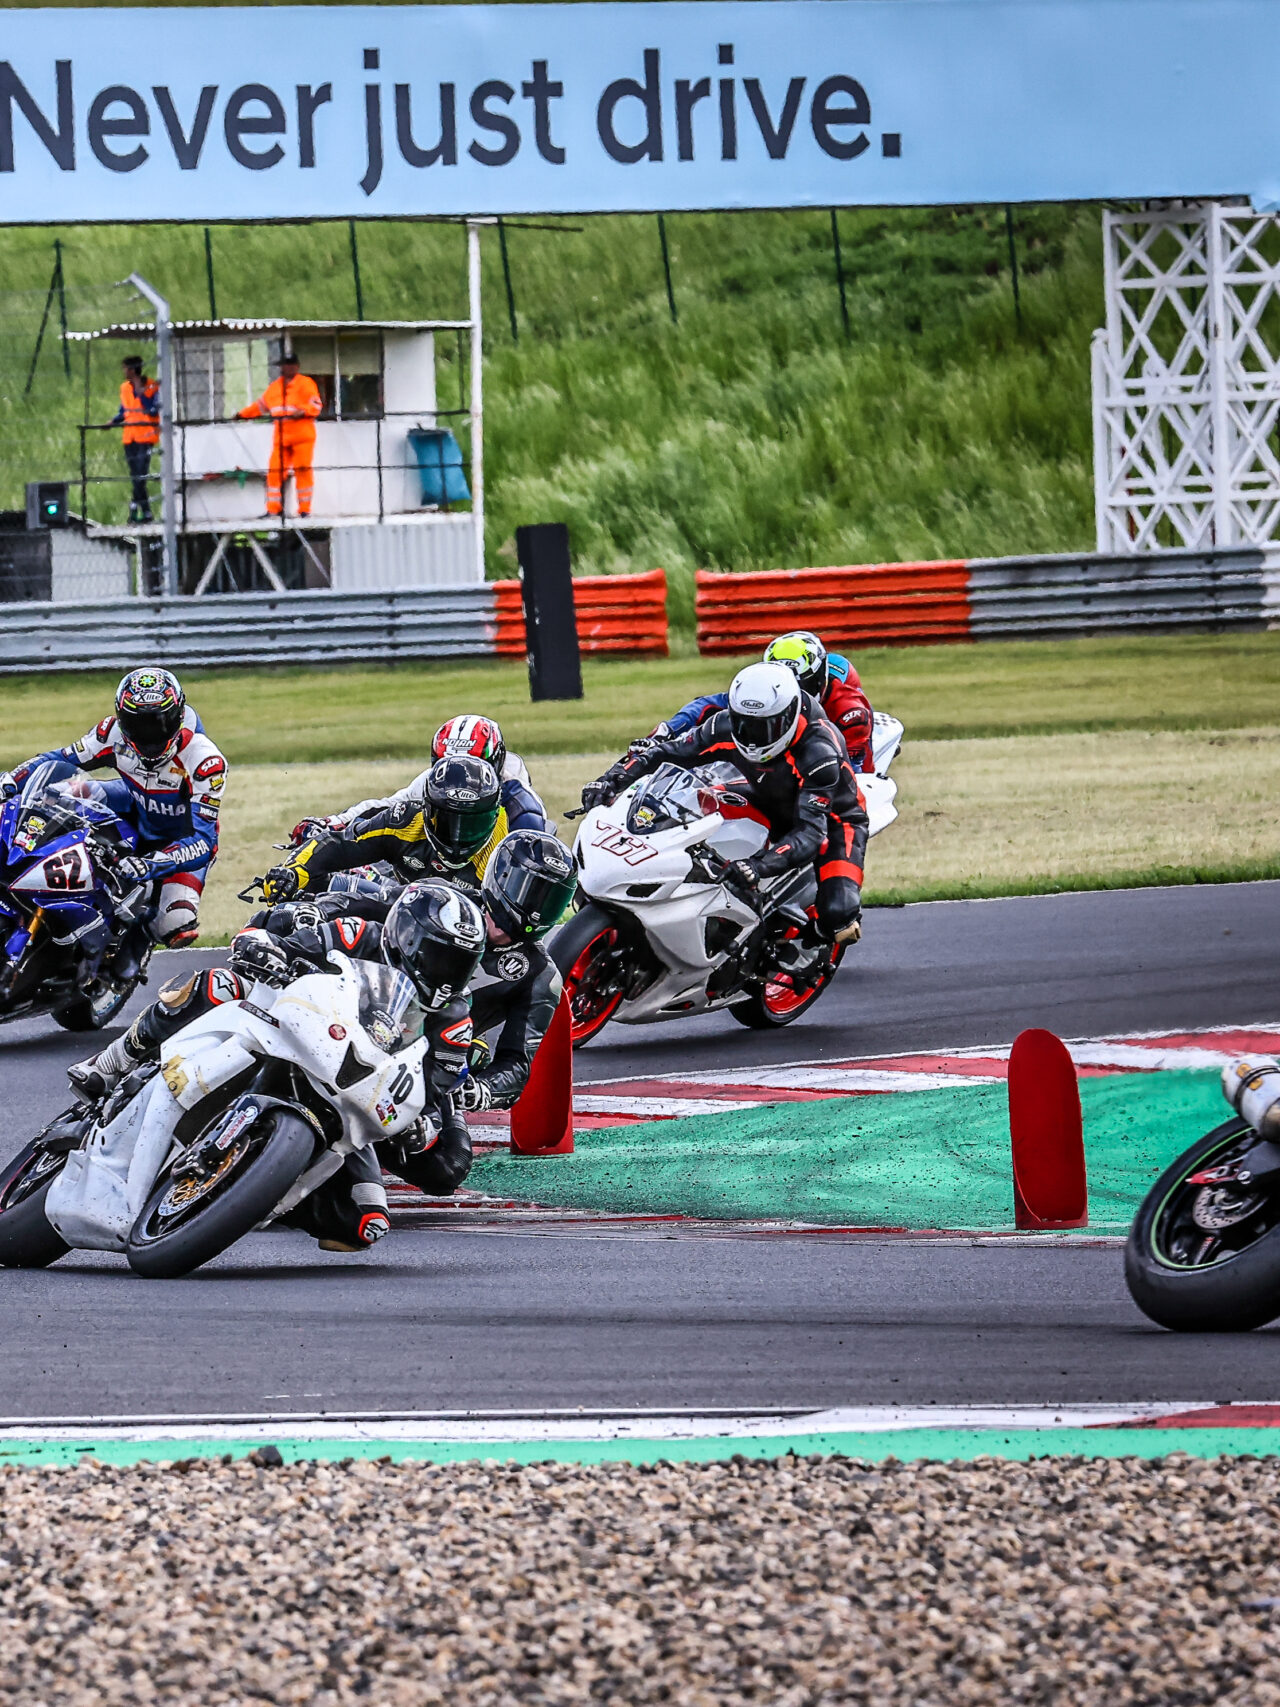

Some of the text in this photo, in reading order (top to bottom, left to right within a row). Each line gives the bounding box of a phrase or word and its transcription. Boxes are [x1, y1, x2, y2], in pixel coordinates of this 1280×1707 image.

[360, 47, 566, 196] just
[596, 43, 902, 164] drive.
[442, 739, 477, 748] NOLAN
[43, 849, 87, 892] 62
[168, 839, 210, 864] YAMAHA
[389, 1063, 415, 1105] 10
